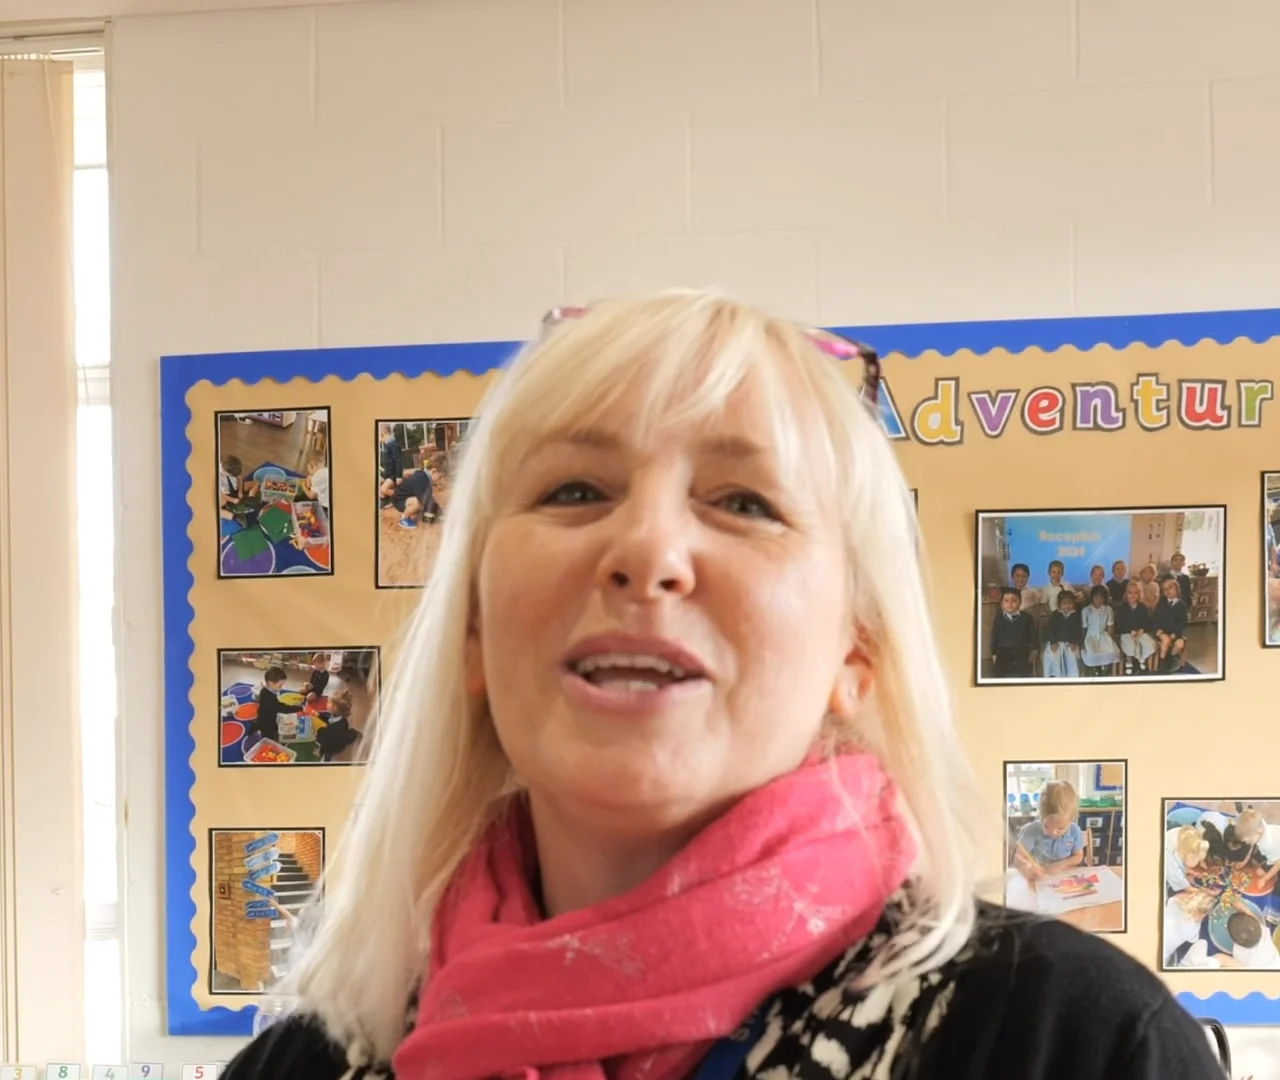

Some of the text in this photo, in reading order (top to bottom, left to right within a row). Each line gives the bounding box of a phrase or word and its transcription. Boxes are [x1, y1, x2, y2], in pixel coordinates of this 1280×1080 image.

[13, 1067, 23, 1080] 3
[58, 1065, 68, 1079] 8
[105, 1068, 115, 1080] 4
[141, 1065, 150, 1078] 9
[194, 1066, 204, 1079] 5
